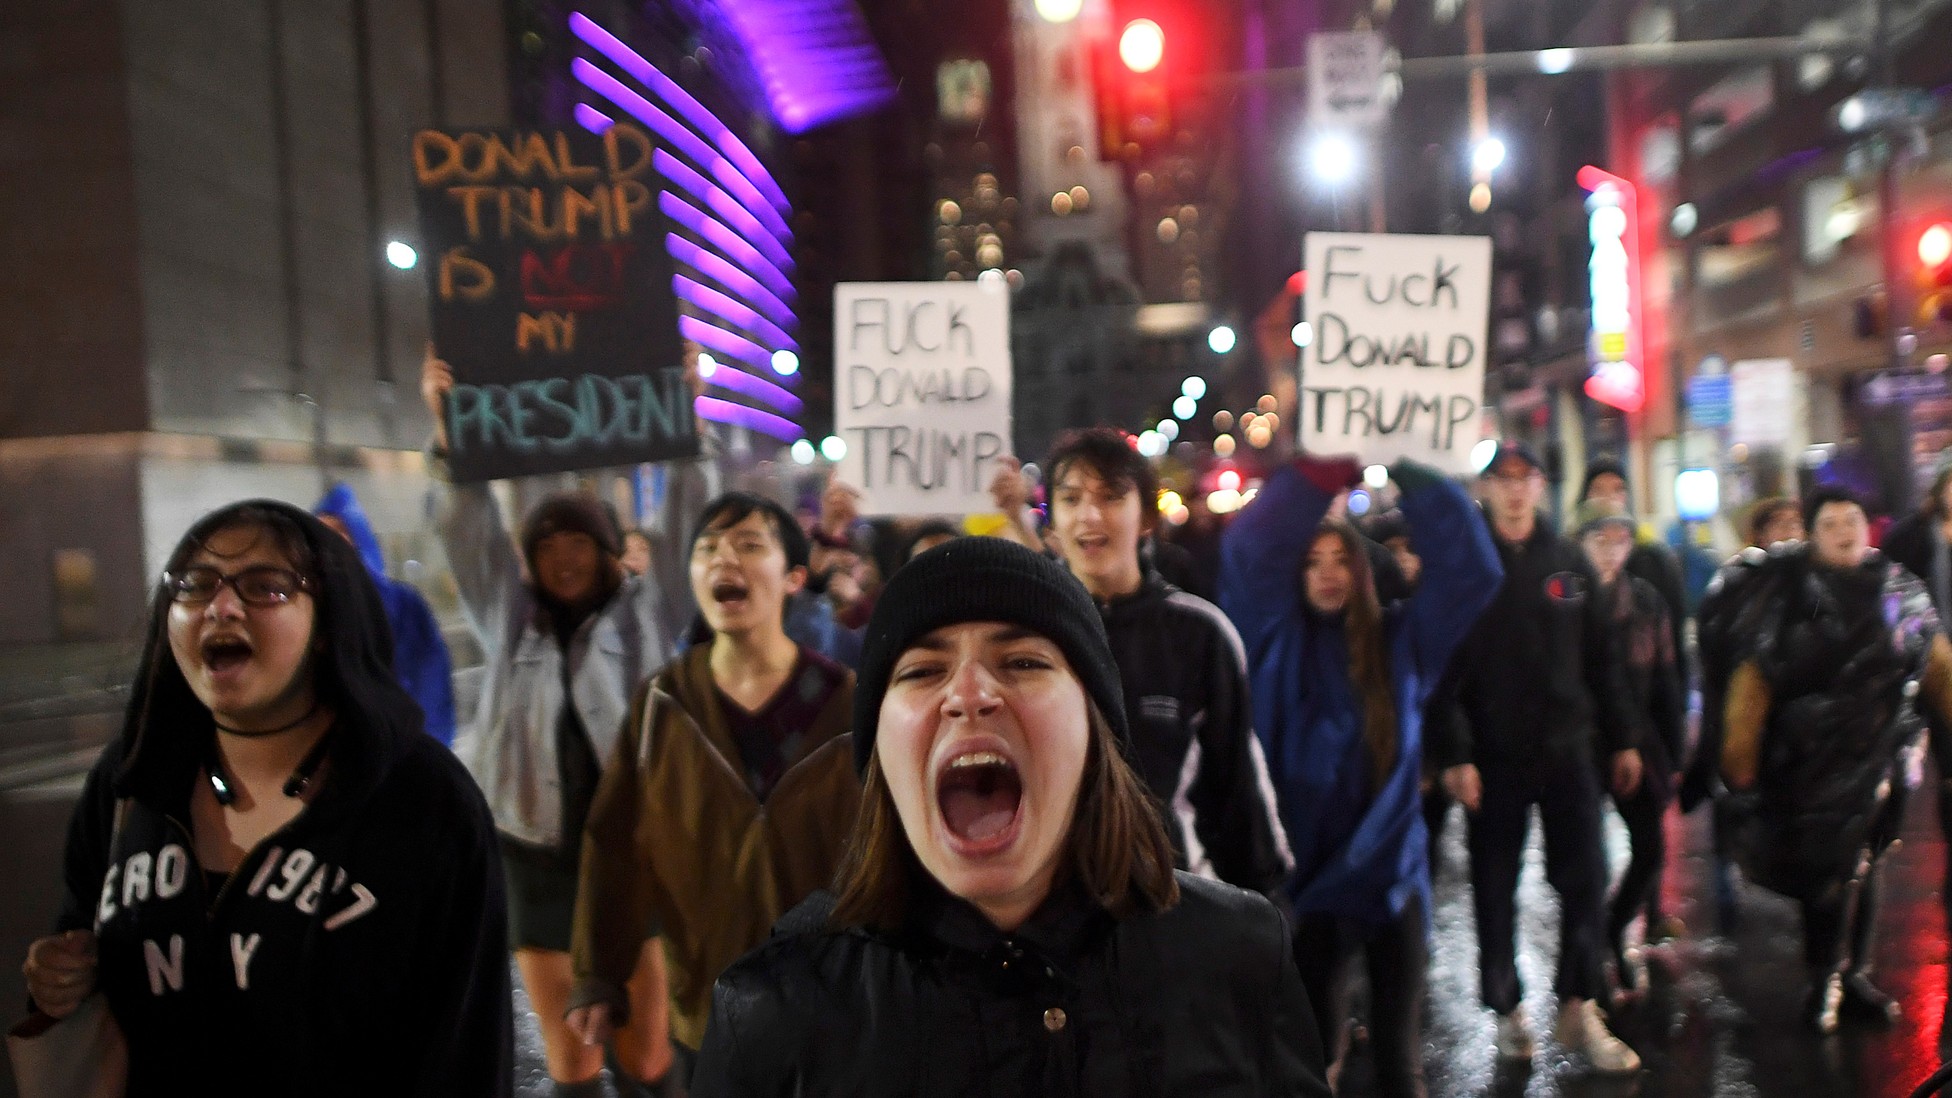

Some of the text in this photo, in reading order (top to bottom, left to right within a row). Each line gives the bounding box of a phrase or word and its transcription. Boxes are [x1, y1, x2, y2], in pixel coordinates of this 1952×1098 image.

[412, 122, 651, 188] DONALD
[446, 179, 650, 240] TRUMP
[519, 244, 636, 296] NOT
[516, 310, 577, 351] MY
[1316, 312, 1475, 369] DONALD
[450, 366, 697, 451] PRESIDENT
[849, 363, 991, 411] DONALD
[1304, 385, 1475, 450] TRUMP
[845, 425, 1001, 493] TRUMP
[94, 843, 187, 936] ERO
